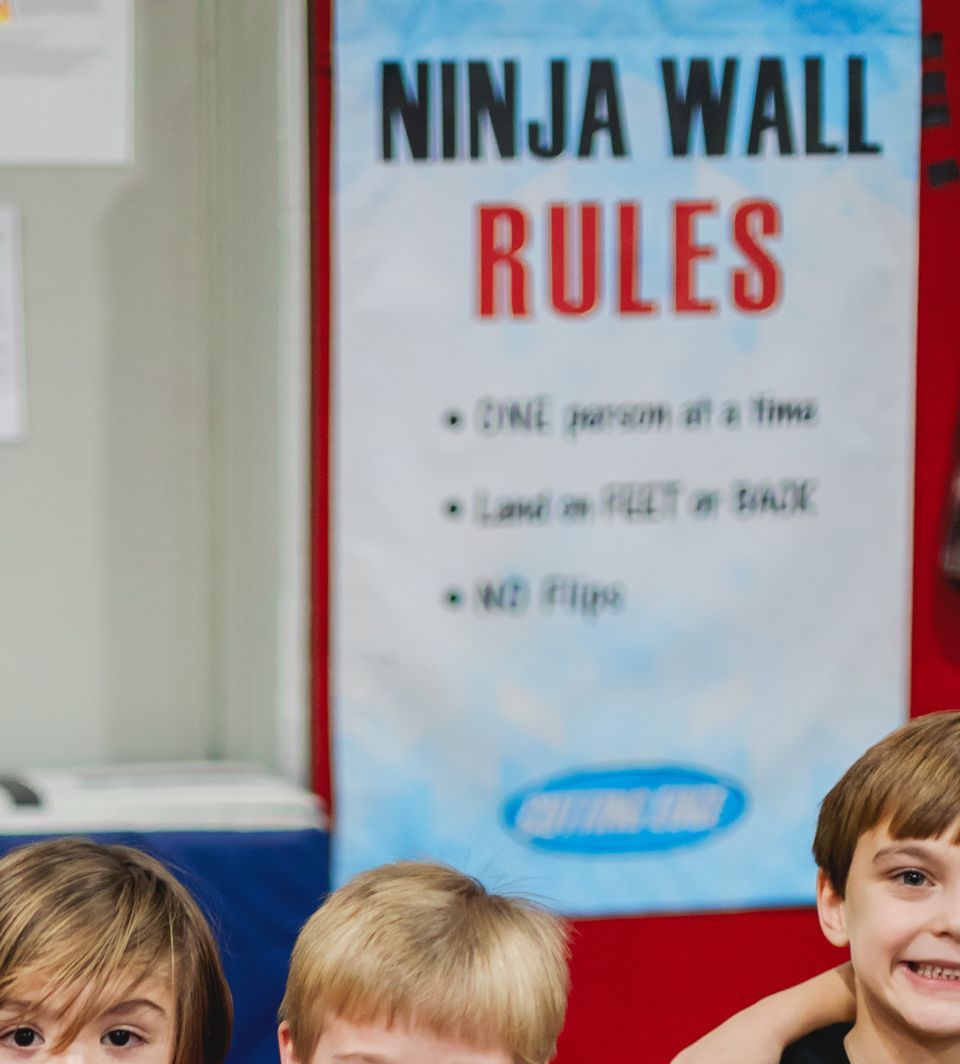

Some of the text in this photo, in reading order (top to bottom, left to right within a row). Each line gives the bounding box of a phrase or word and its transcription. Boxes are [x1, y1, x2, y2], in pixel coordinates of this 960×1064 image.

[379, 56, 882, 160] NINJA WALL
[476, 200, 783, 319] RULES
[477, 394, 817, 441] ONE person at a time
[475, 479, 817, 526] Land on FEET or BACK
[477, 575, 626, 622] NO Flips
